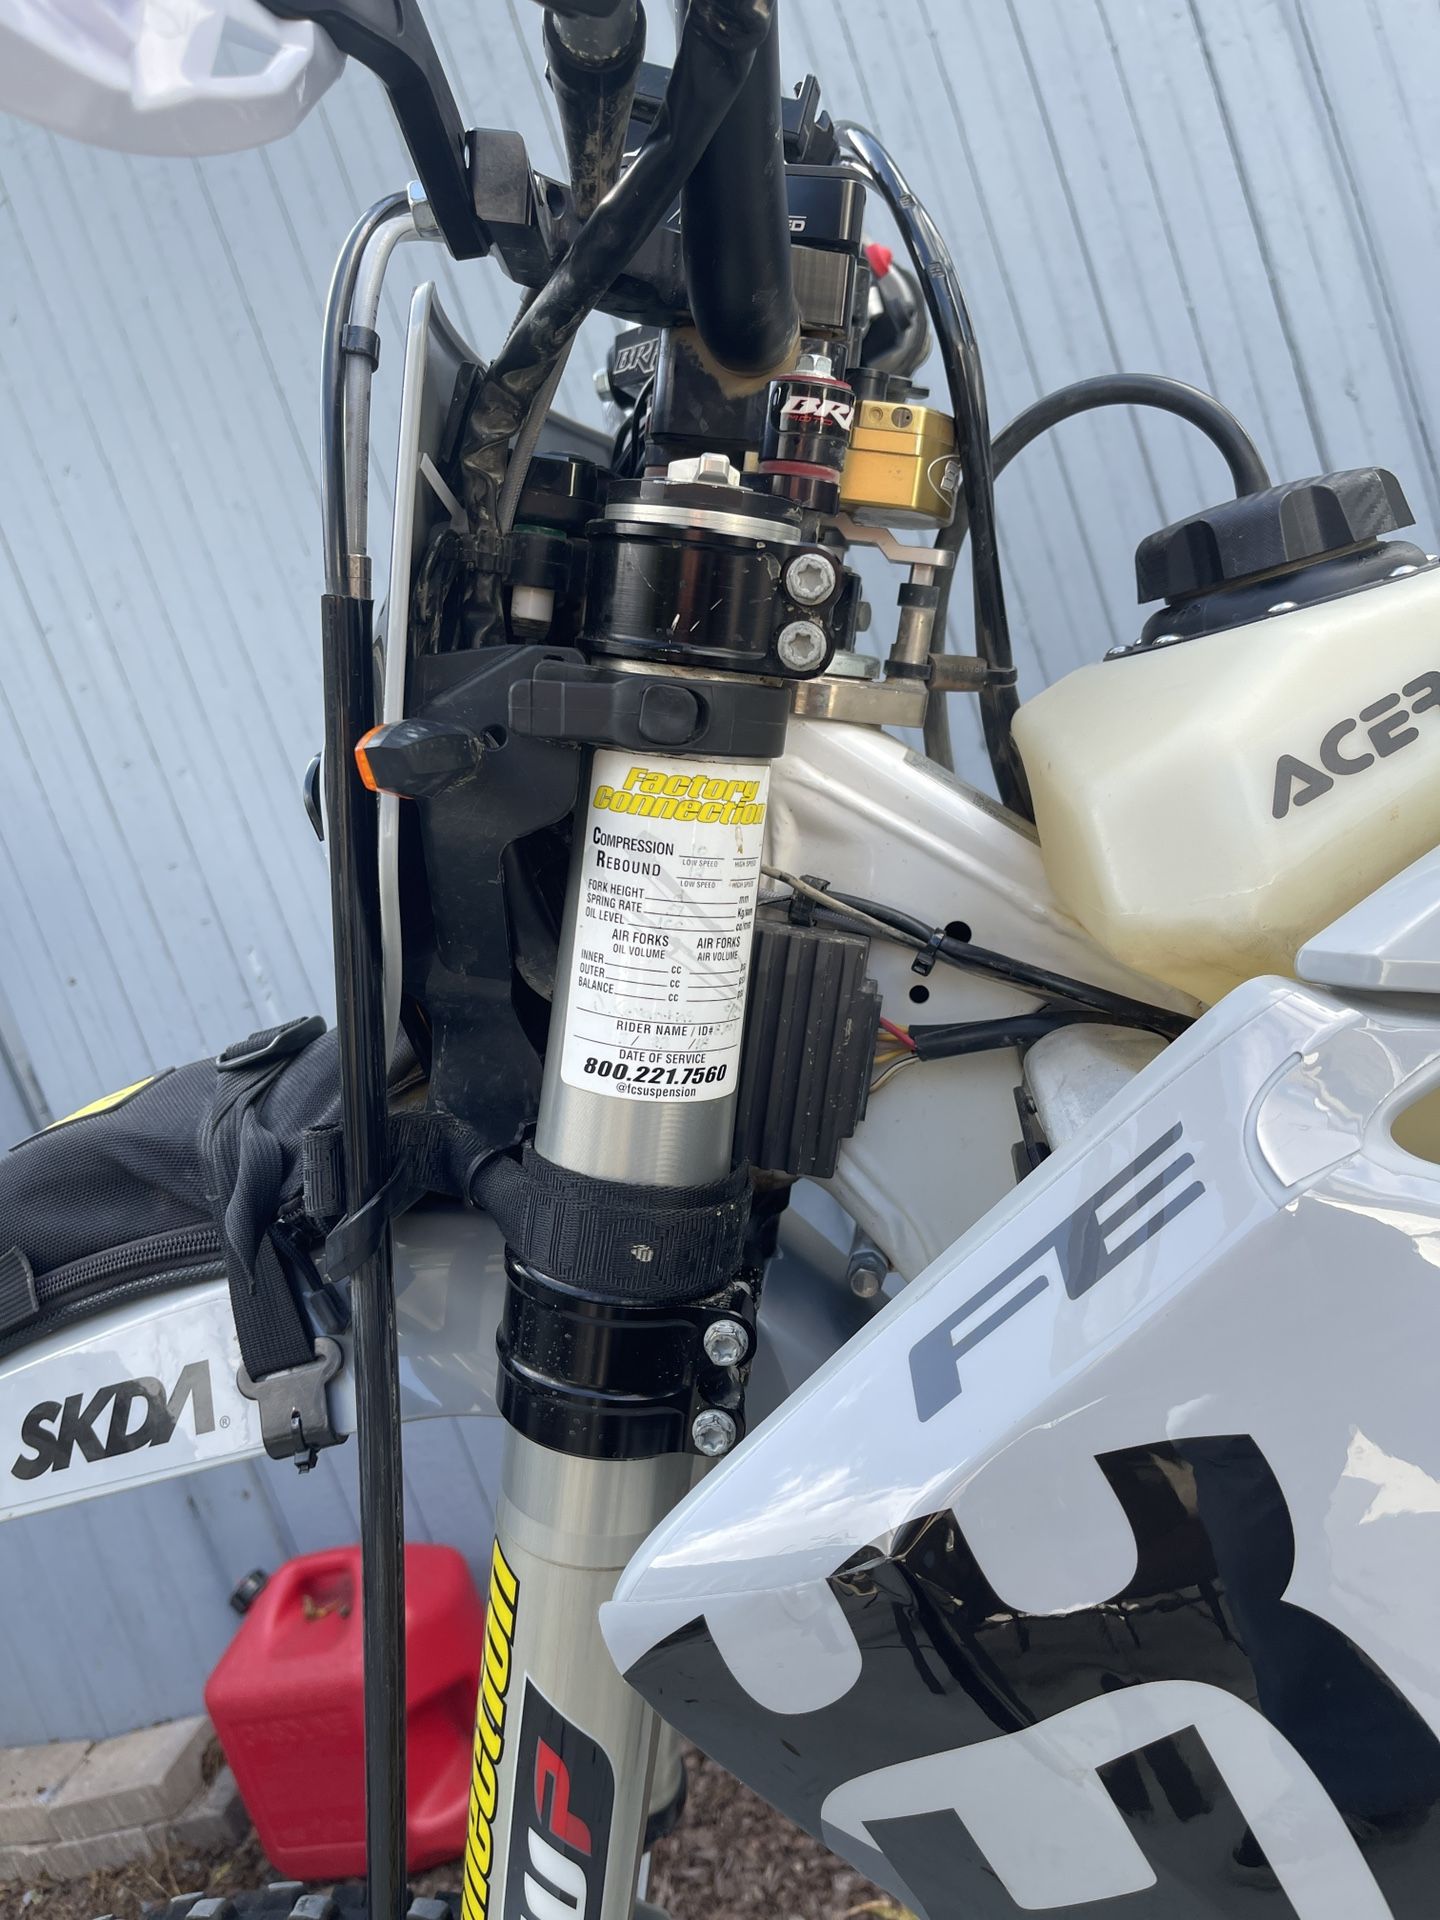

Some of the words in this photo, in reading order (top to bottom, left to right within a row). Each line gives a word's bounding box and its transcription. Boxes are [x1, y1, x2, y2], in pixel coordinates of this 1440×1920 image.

[622, 766, 761, 802] Factory
[592, 784, 767, 826] Connection
[593, 826, 674, 856] COMPRESSION
[596, 850, 661, 877] REBOUND
[682, 858, 698, 867] LOW
[588, 878, 608, 893] FORK
[610, 883, 645, 899] HEIGHT
[680, 880, 695, 888] LOW
[696, 881, 716, 889] SPEED
[587, 892, 616, 909] SPRING
[618, 899, 643, 913] RATE
[585, 906, 597, 919] OIL
[598, 909, 625, 925] LEVEL
[611, 928, 630, 942] AIR
[632, 931, 669, 947] FORKS
[696, 937, 714, 949] AIR
[715, 936, 741, 949] FORKS
[581, 948, 604, 964] INNER
[612, 943, 626, 955] OIL
[628, 946, 666, 960] VOLUME
[697, 952, 711, 962] AIR
[711, 950, 738, 961] VOLUME
[580, 962, 605, 978] OUTER
[578, 975, 615, 995] BALANCE
[616, 1019, 651, 1034] RIDER
[655, 1025, 688, 1037] NAME
[690, 1026, 696, 1037] /
[697, 1025, 714, 1036] ID#
[619, 1049, 645, 1062] DATE
[649, 1051, 662, 1063] OF
[665, 1053, 706, 1064] SERVICE
[583, 1057, 728, 1085] 800.221.7560
[616, 1081, 697, 1099] @fcsuspension
